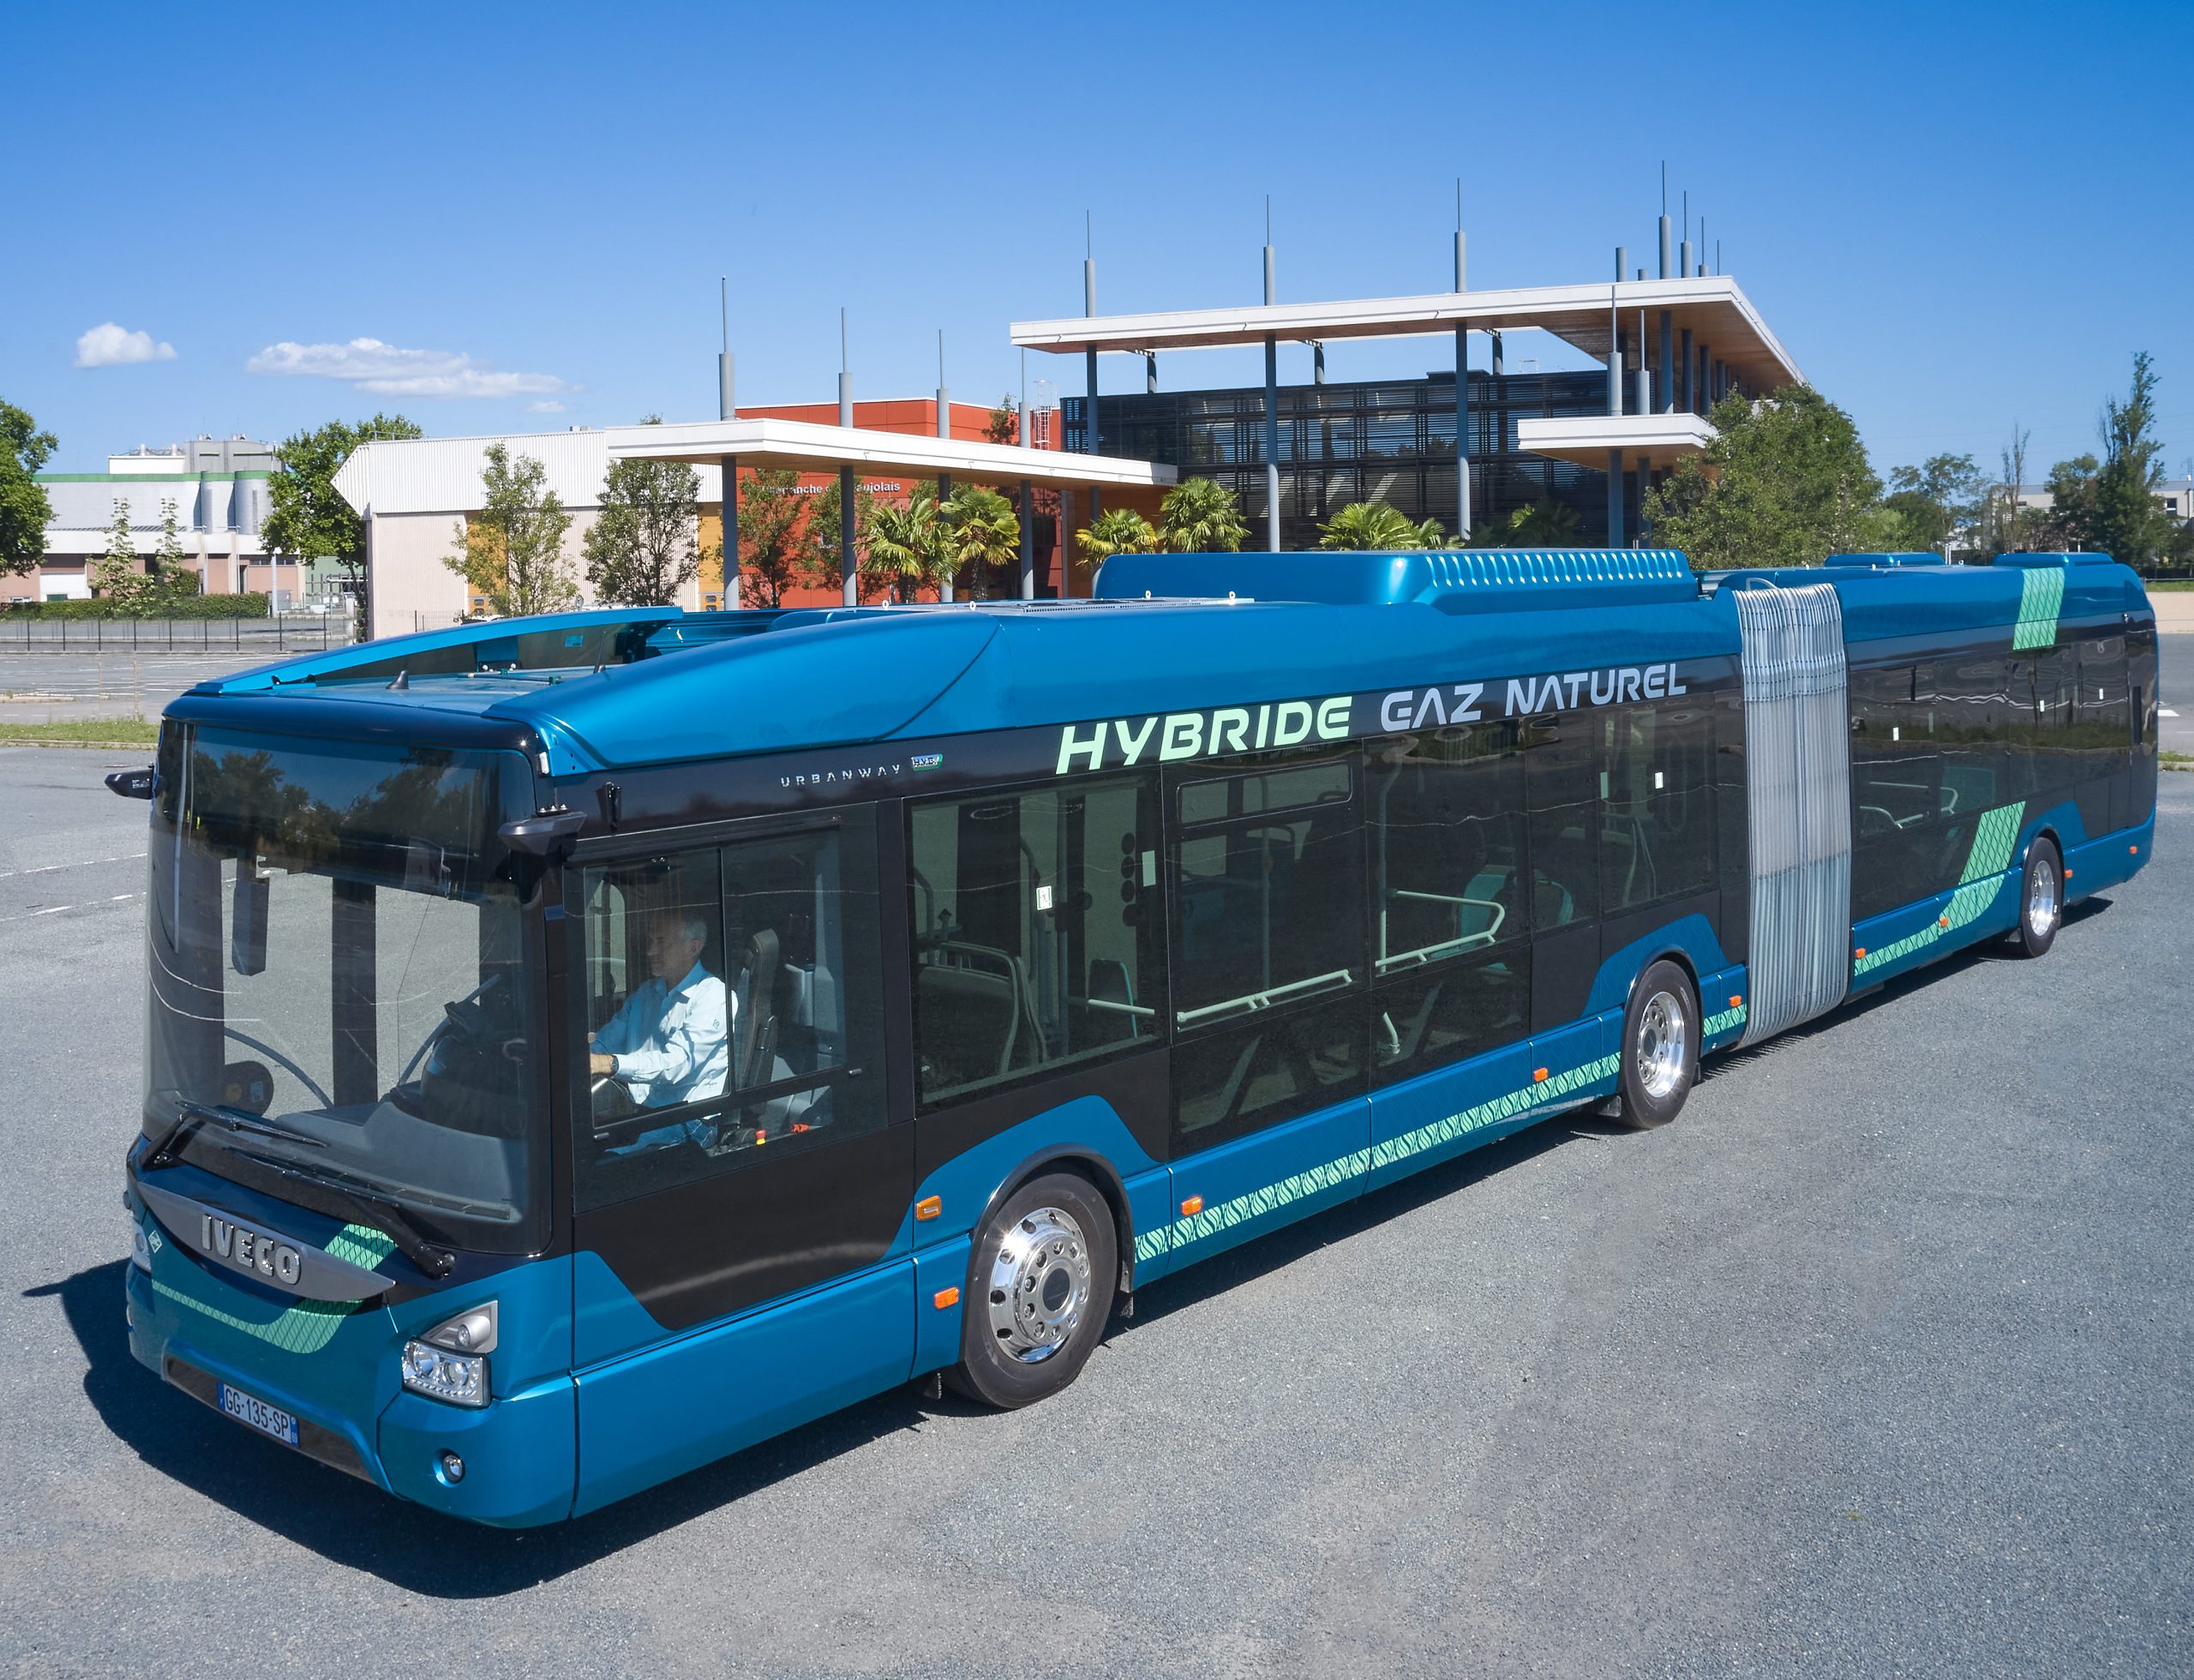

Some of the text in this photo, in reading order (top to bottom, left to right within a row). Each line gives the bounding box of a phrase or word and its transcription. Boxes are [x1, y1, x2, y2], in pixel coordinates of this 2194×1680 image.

[854, 482, 901, 495] aujolais
[1055, 663, 1687, 775] HYBRIDE GAZ NATUREL
[780, 764, 901, 788] URBANWAY
[201, 1213, 302, 1286] IVECO
[225, 1387, 290, 1437] GG-135-SP
